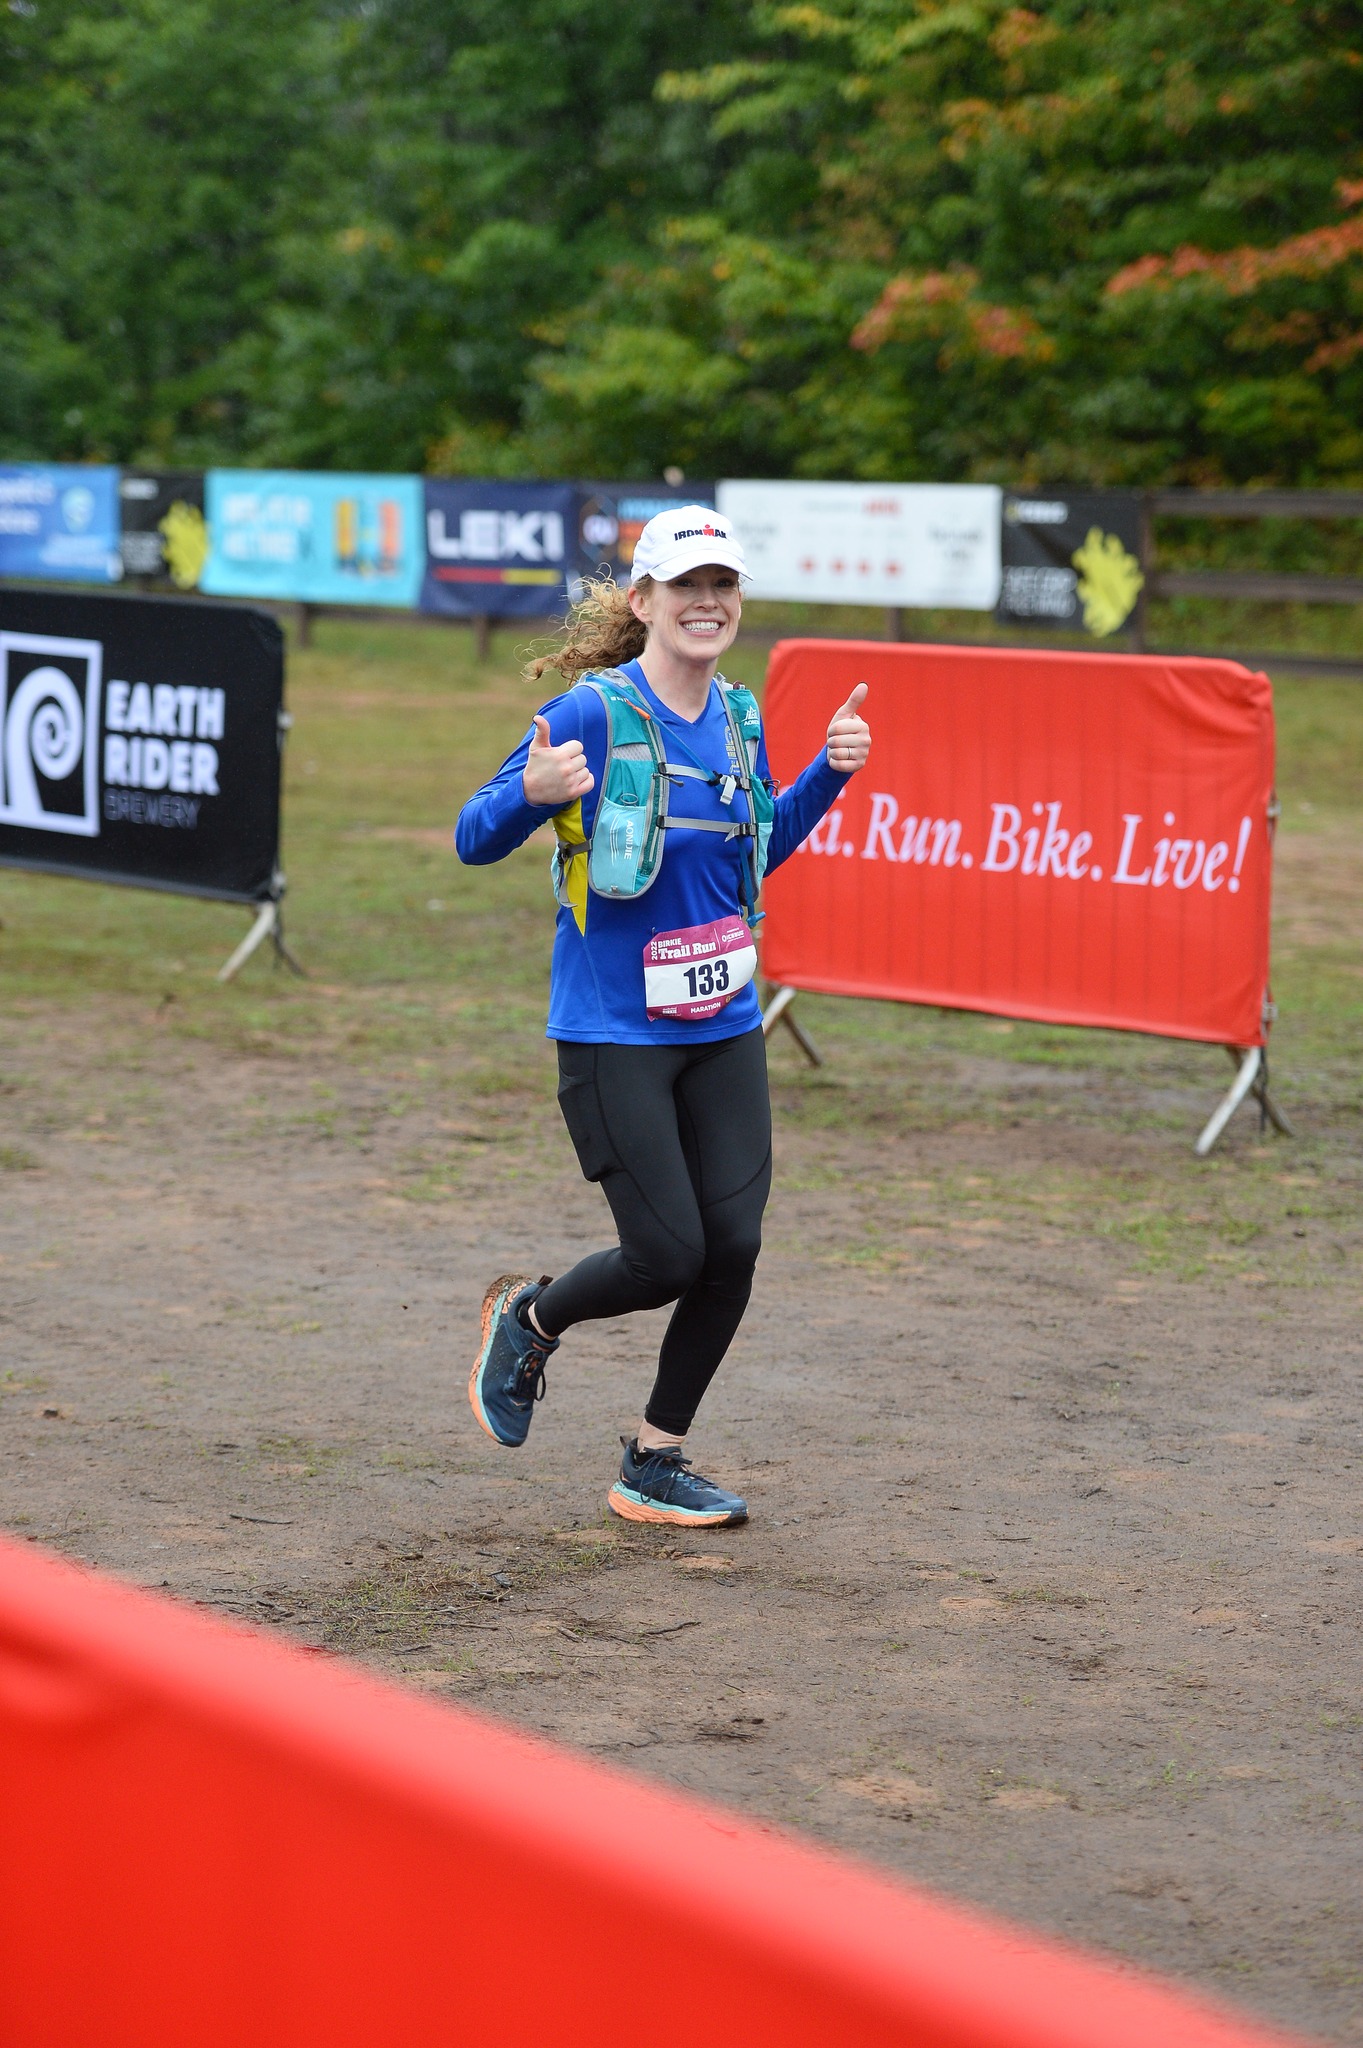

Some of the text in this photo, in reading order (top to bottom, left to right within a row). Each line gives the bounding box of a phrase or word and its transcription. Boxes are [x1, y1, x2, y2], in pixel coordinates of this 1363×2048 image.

[427, 509, 565, 561] LEKI
[105, 679, 225, 740] EARTH
[104, 734, 220, 796] RIDER
[104, 788, 200, 830] BREWERY
[624, 820, 634, 860] AONIJIE
[861, 792, 973, 868] Run.
[980, 801, 1103, 882] Bike.
[1111, 812, 1252, 893] Live!
[650, 941, 658, 961] 2022
[658, 938, 682, 948] BIRKIE
[658, 942, 716, 960] Trail Run
[683, 959, 730, 998] 133
